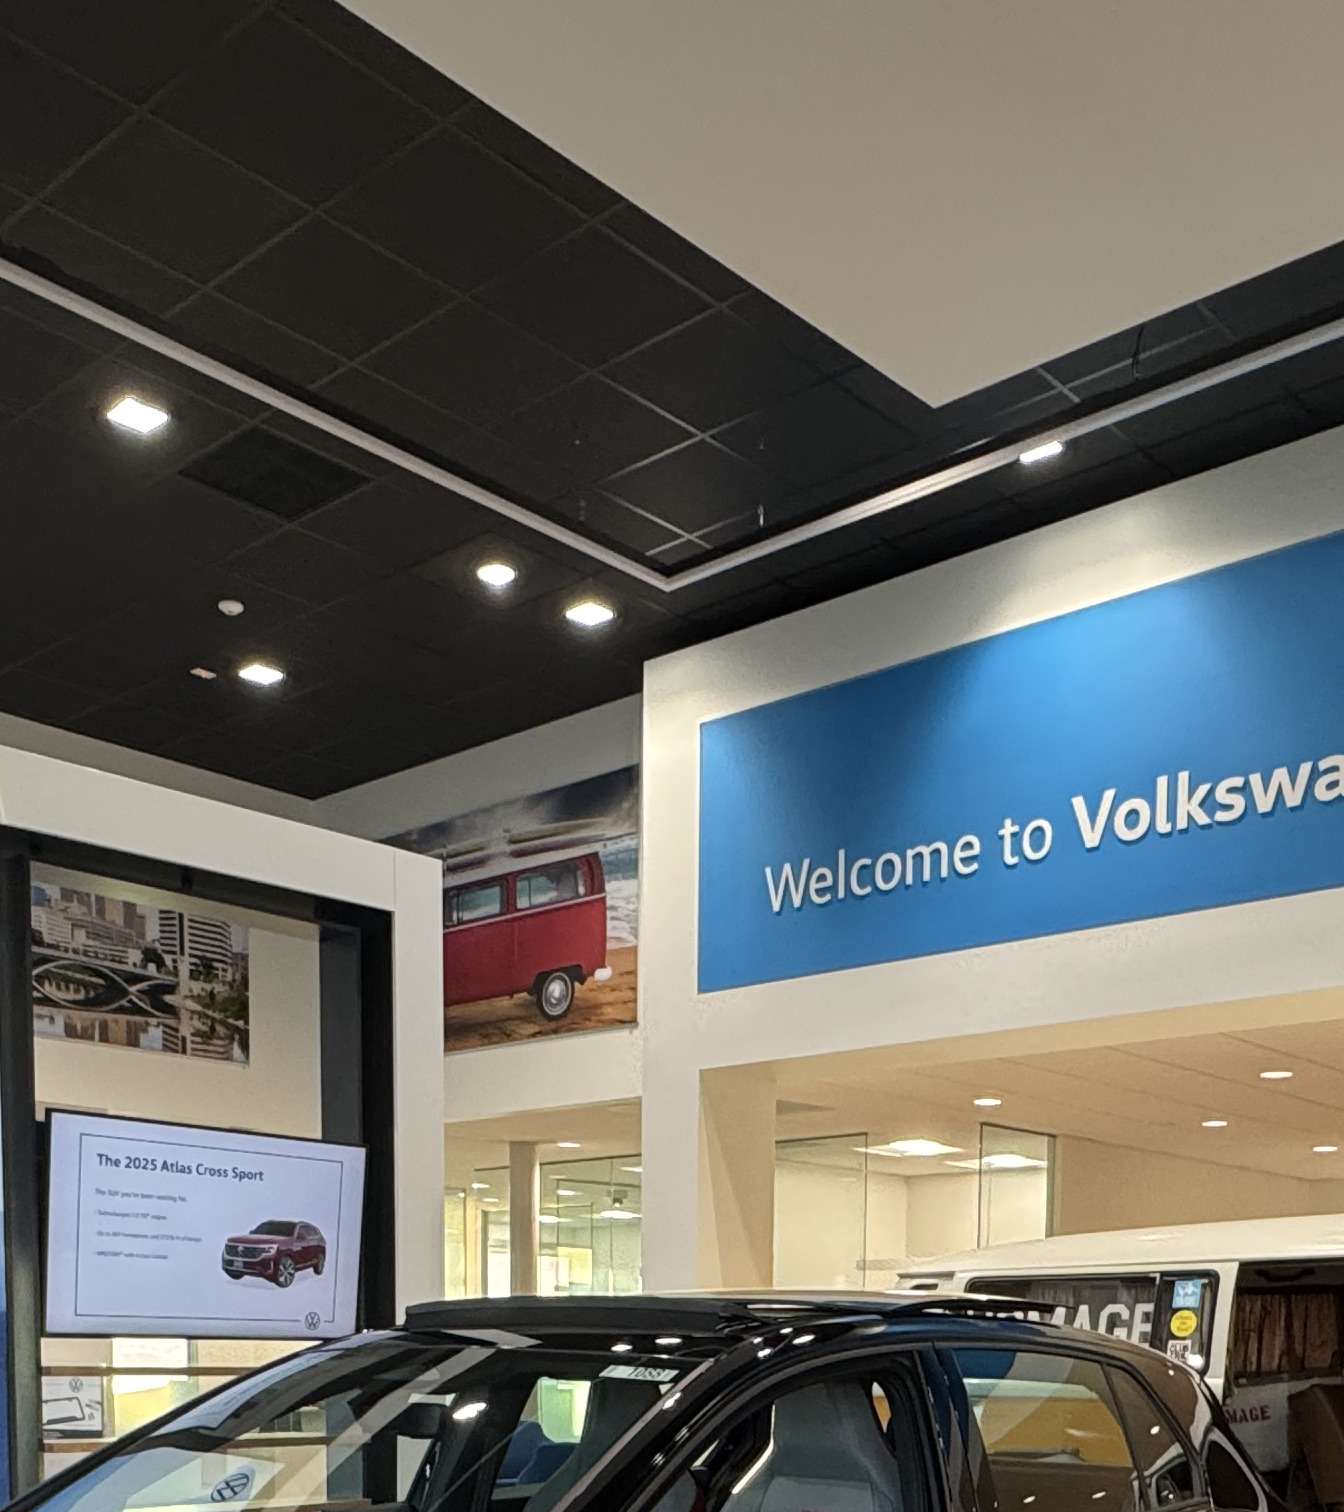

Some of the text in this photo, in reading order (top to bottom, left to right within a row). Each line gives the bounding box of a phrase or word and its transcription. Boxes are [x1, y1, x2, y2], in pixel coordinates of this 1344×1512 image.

[764, 834, 981, 912] Welcome
[998, 815, 1053, 867] to
[97, 1153, 264, 1182] The 2025 Atlas Cross Sport
